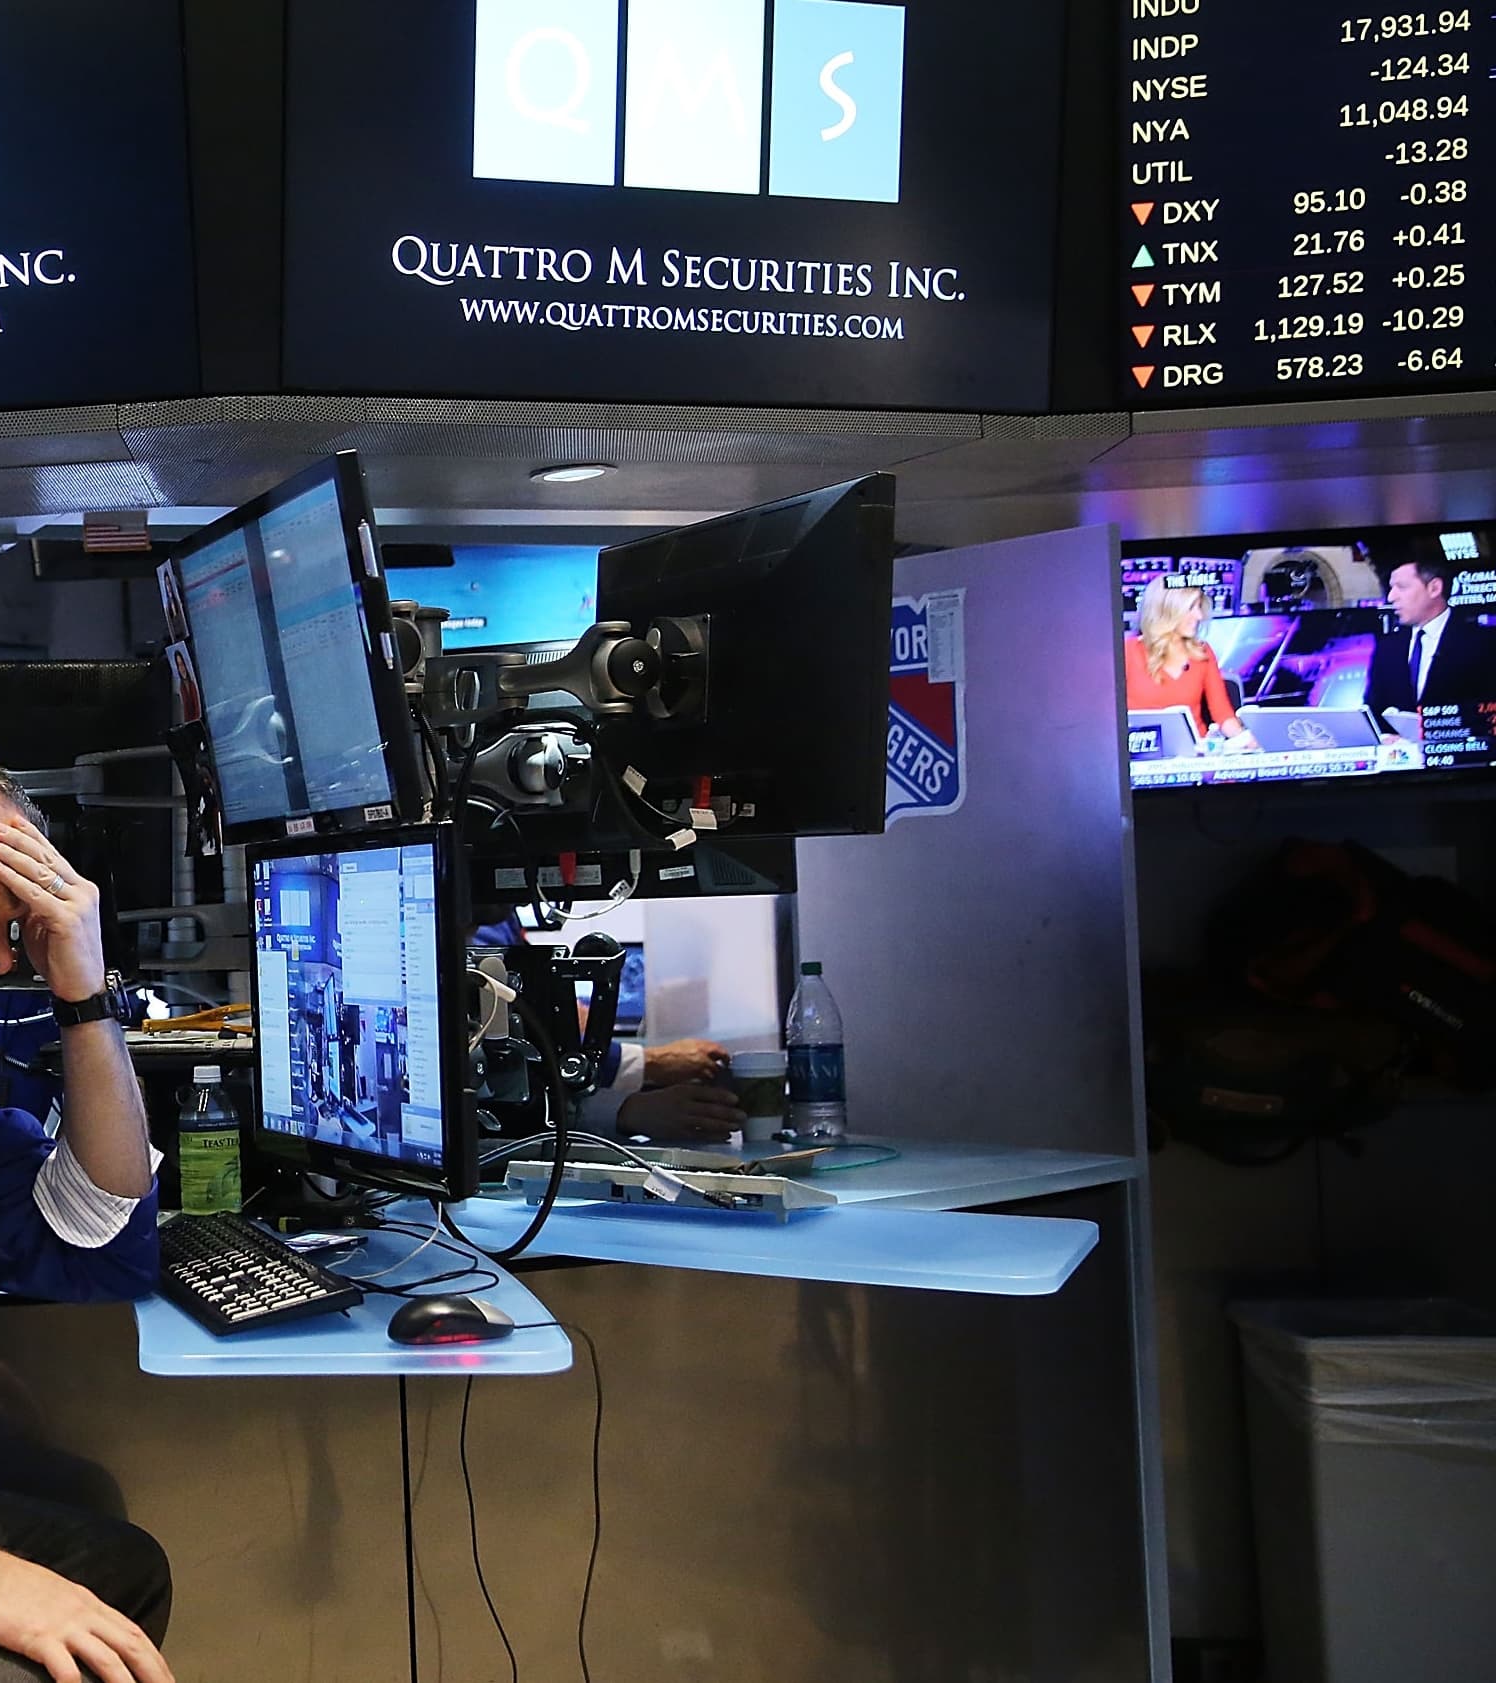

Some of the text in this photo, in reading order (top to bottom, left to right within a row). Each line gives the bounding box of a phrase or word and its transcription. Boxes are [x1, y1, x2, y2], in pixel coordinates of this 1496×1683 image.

[1133, 0, 1199, 18] INDU
[1133, 9, 1472, 61] INDP 17,931.94
[1132, 52, 1470, 103] NYSE -124.34
[1132, 95, 1469, 144] NYA 11,048.94
[1132, 137, 1468, 185] UTIL -13.28
[1163, 180, 1467, 225] DXY 95.10 -0.38
[1161, 222, 1466, 265] TNX 21.76 +0.41
[391, 235, 965, 301] QUATTRO M SECURITIES INC.
[1161, 263, 1465, 306] TYM 127.52 +0.25
[459, 298, 905, 340] WWW.QUATTROMSECURITIES.COM
[1163, 305, 1464, 347] RLX 1,129.19 -10.29
[1163, 347, 1464, 388] DRG 578.23 -6.64
[892, 623, 928, 662] OR
[1424, 716, 1463, 729] CHANGE
[887, 724, 951, 795] GERS
[1425, 742, 1465, 754] CLOSING
